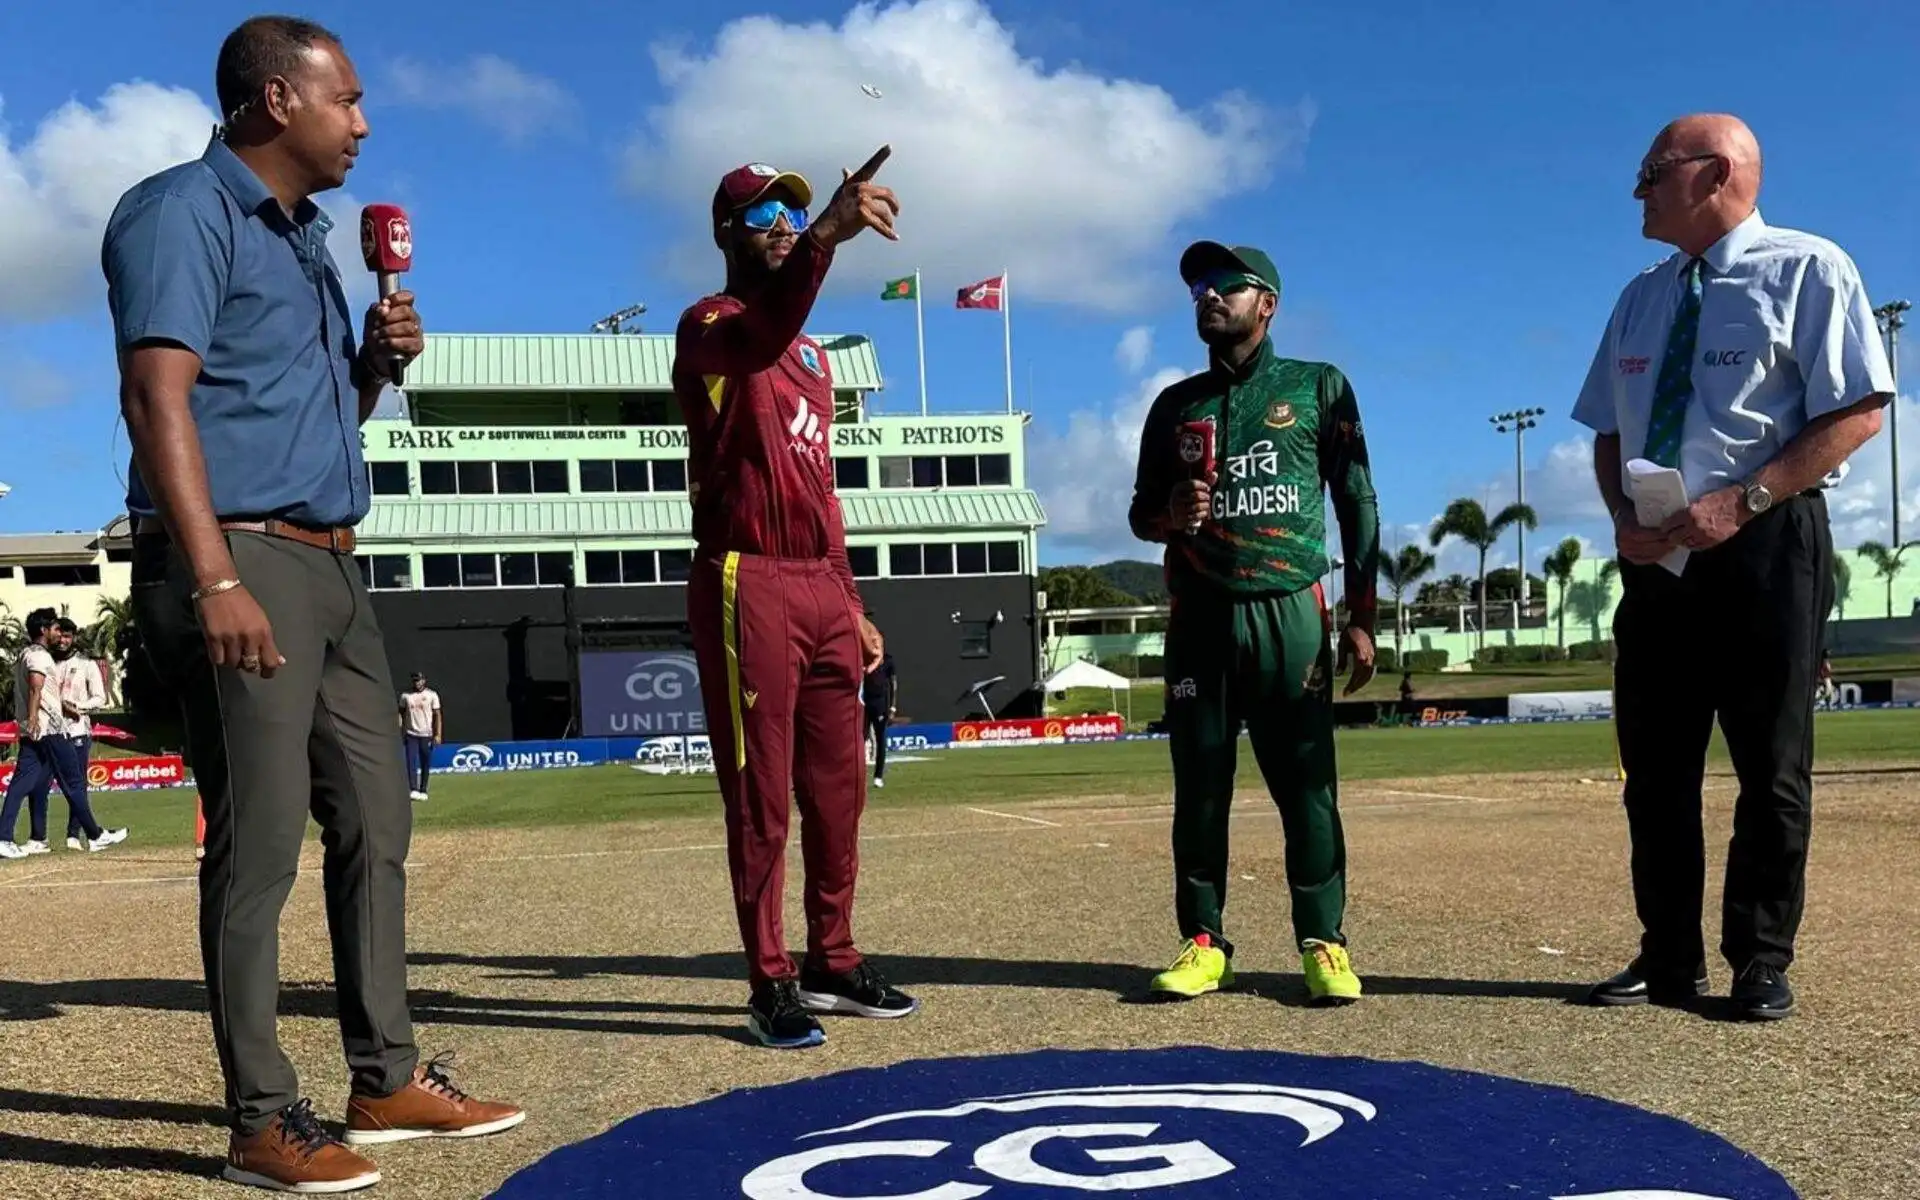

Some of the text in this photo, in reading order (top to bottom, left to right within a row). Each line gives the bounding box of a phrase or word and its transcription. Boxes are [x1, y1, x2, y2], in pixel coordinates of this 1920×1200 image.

[1717, 350, 1746, 365] ICC
[387, 430, 455, 449] PARK
[489, 430, 551, 441] SOUTHWELL
[553, 430, 585, 440] MEDIA
[588, 430, 626, 440] CENTER
[638, 425, 1004, 448] HOM SKN PATRIOTS
[1226, 439, 1279, 482] রবি
[1212, 483, 1300, 520] GLADESH
[624, 671, 683, 701] CG
[1171, 678, 1197, 700] রবি
[610, 711, 704, 732] UNITE
[1065, 721, 1117, 737] dafabet
[886, 735, 928, 748] ITED
[980, 725, 1032, 740] dafabet
[452, 754, 481, 769] CG
[506, 752, 579, 766] UNITED
[113, 764, 176, 781] dafabet
[741, 1122, 1236, 1200] CG
